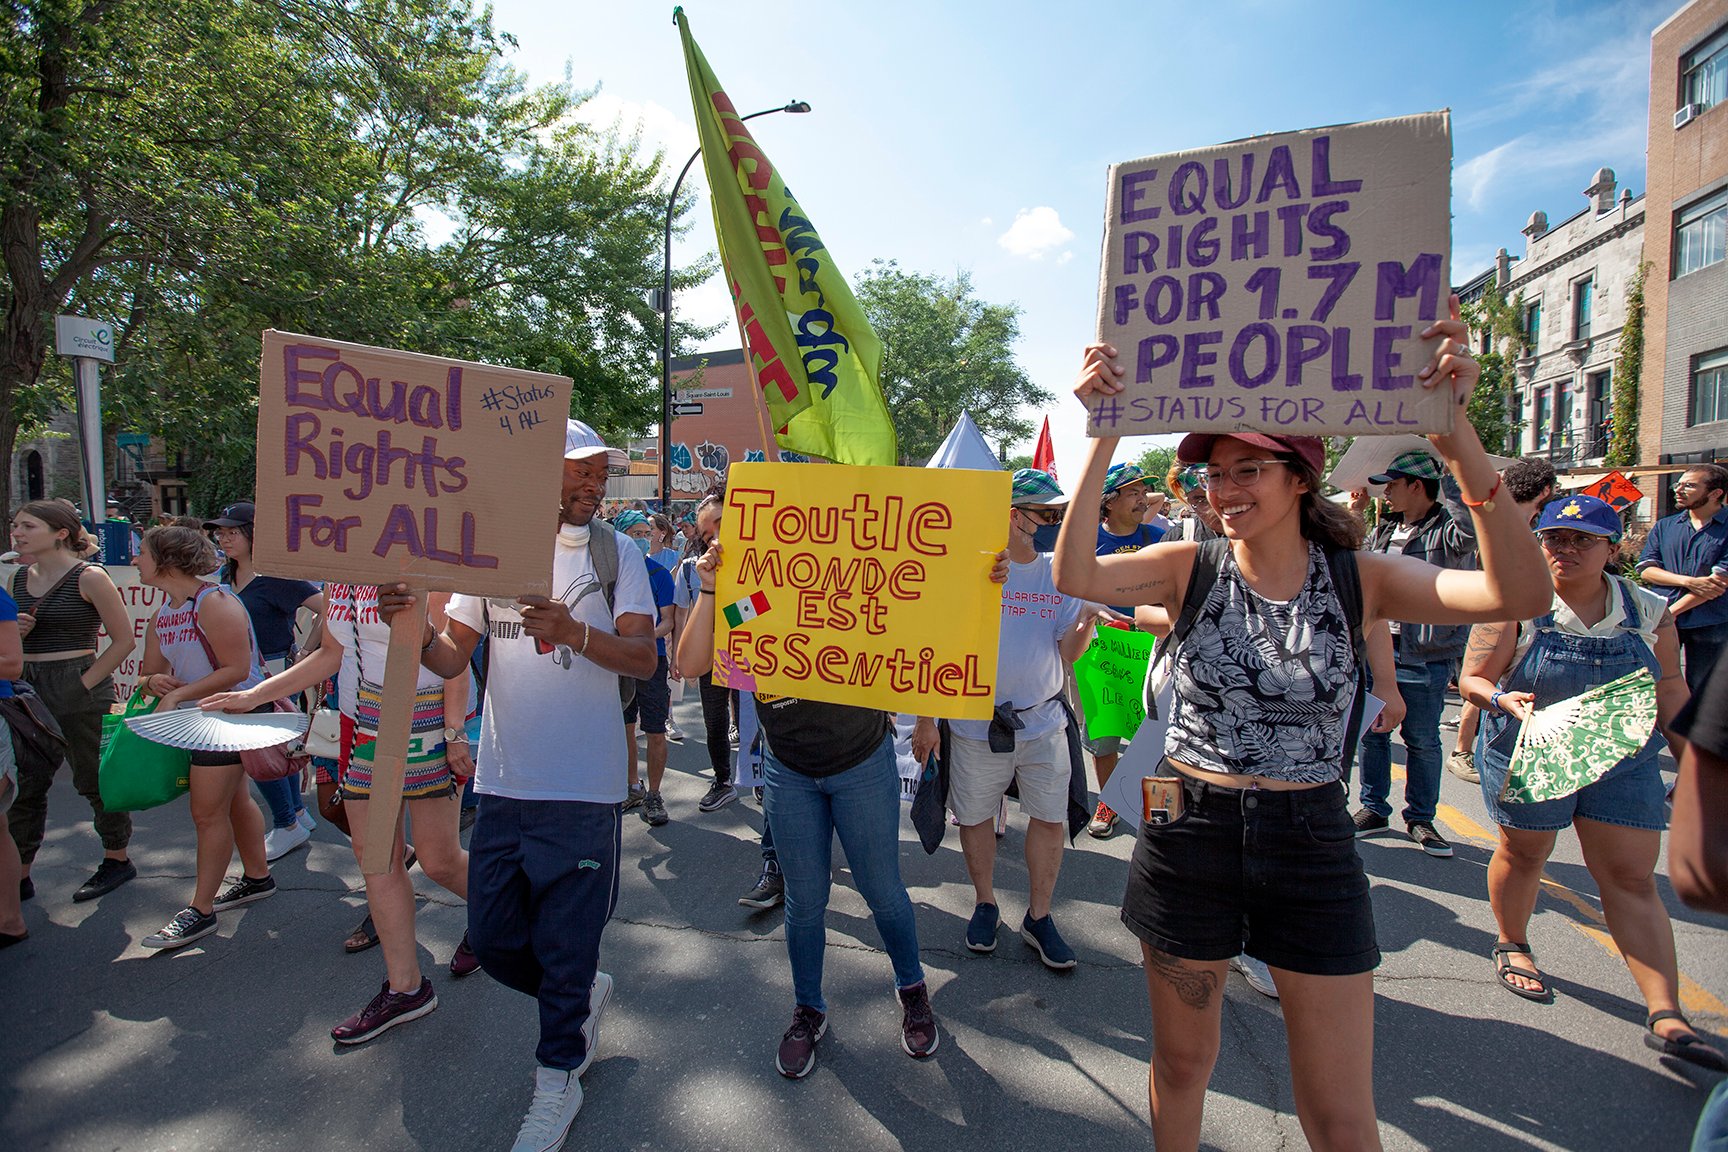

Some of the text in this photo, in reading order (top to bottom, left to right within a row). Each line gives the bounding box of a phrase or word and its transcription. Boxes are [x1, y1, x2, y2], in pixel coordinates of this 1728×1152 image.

[1120, 135, 1363, 225] EQUAL
[1123, 200, 1351, 275] RIGHTS
[1114, 253, 1443, 326] FOR 1.7 M
[1136, 322, 1415, 392] PEOPLE
[500, 410, 548, 435] 4 ALL
[1092, 397, 1418, 428] #STATUS FOR ALL
[285, 412, 468, 500] Rights
[285, 494, 498, 569] For ALL
[1001, 591, 1063, 605] ULARISATIO
[1001, 604, 1027, 616] TTAP
